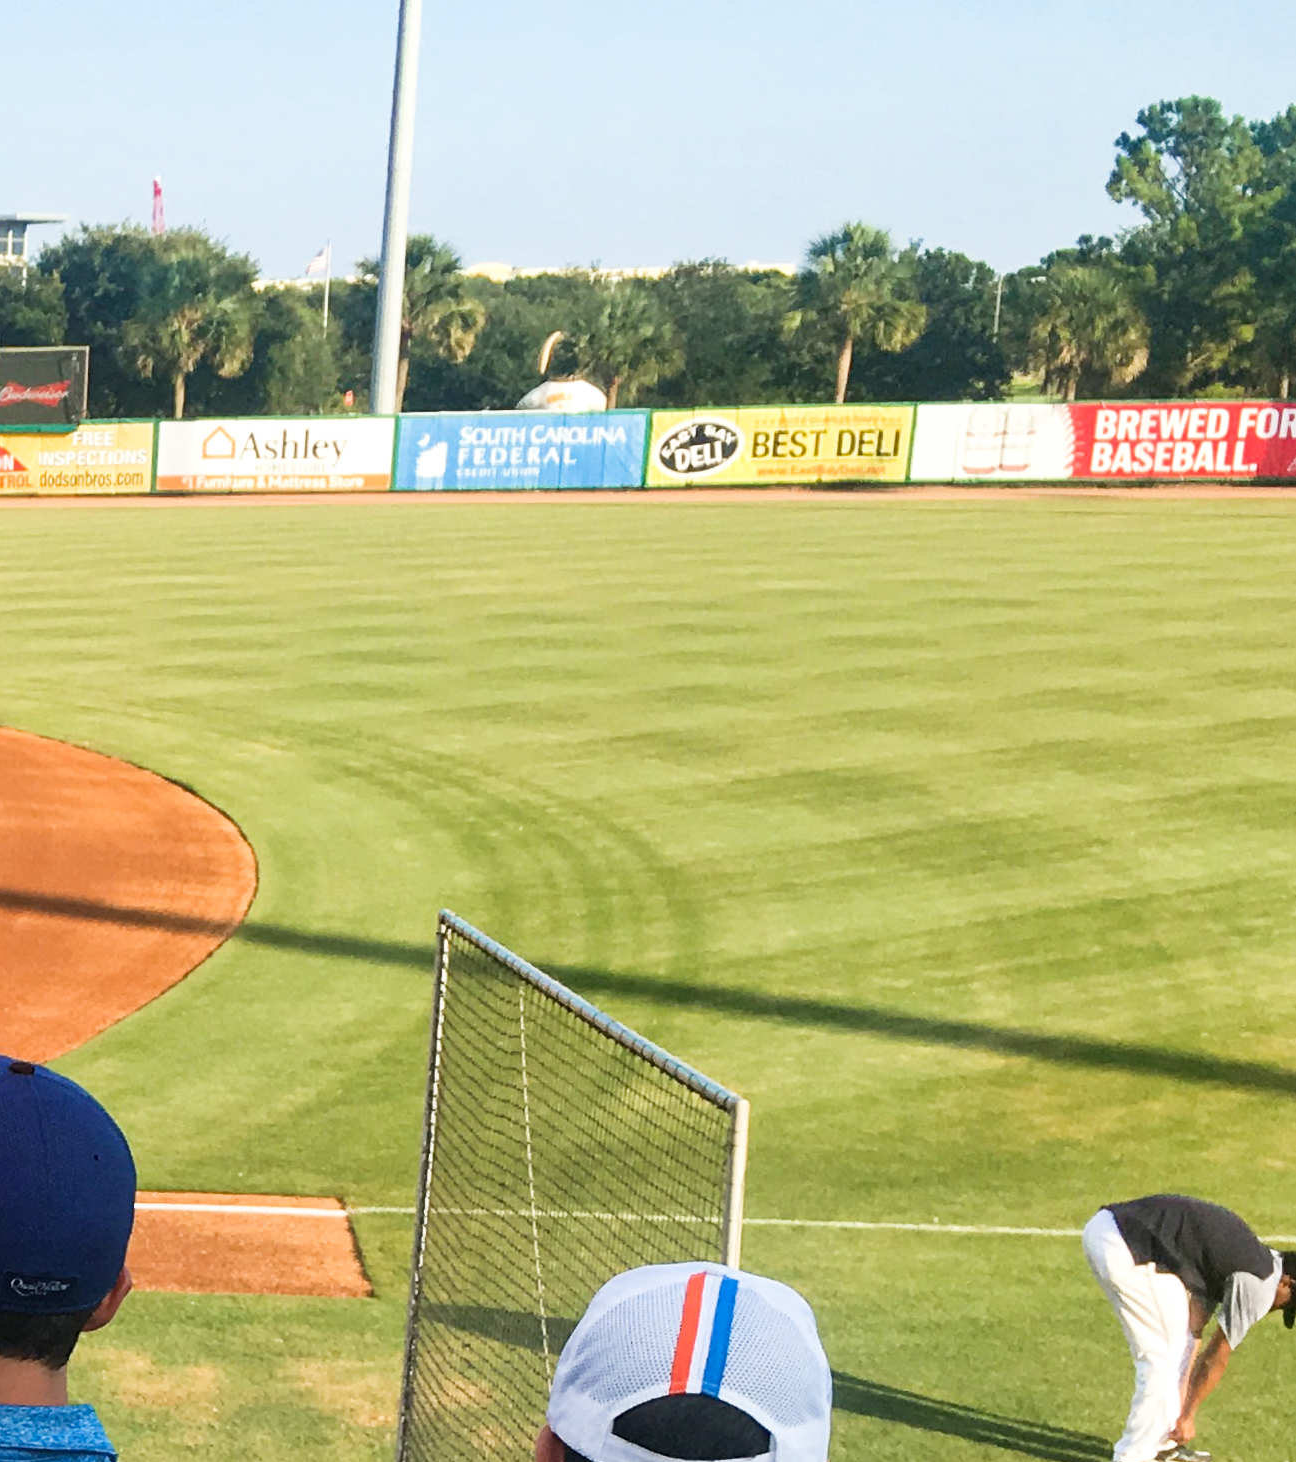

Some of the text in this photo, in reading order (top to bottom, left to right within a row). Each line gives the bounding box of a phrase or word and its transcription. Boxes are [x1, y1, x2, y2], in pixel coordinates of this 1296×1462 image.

[458, 425, 627, 446] SOUTH CAROLINA
[1095, 407, 1296, 441] BREWED FOR
[72, 430, 115, 447] FREE
[240, 428, 348, 468] Ashley
[661, 424, 737, 460] EAST BAY
[751, 428, 901, 459] BEST DELI
[38, 449, 147, 466] INSPECTIONS
[457, 446, 578, 466] FEDERAL
[673, 440, 723, 472] DELI
[1090, 440, 1258, 474] BASEBALL.
[39, 470, 144, 488] dodsonbros.com
[328, 474, 365, 489] Store
